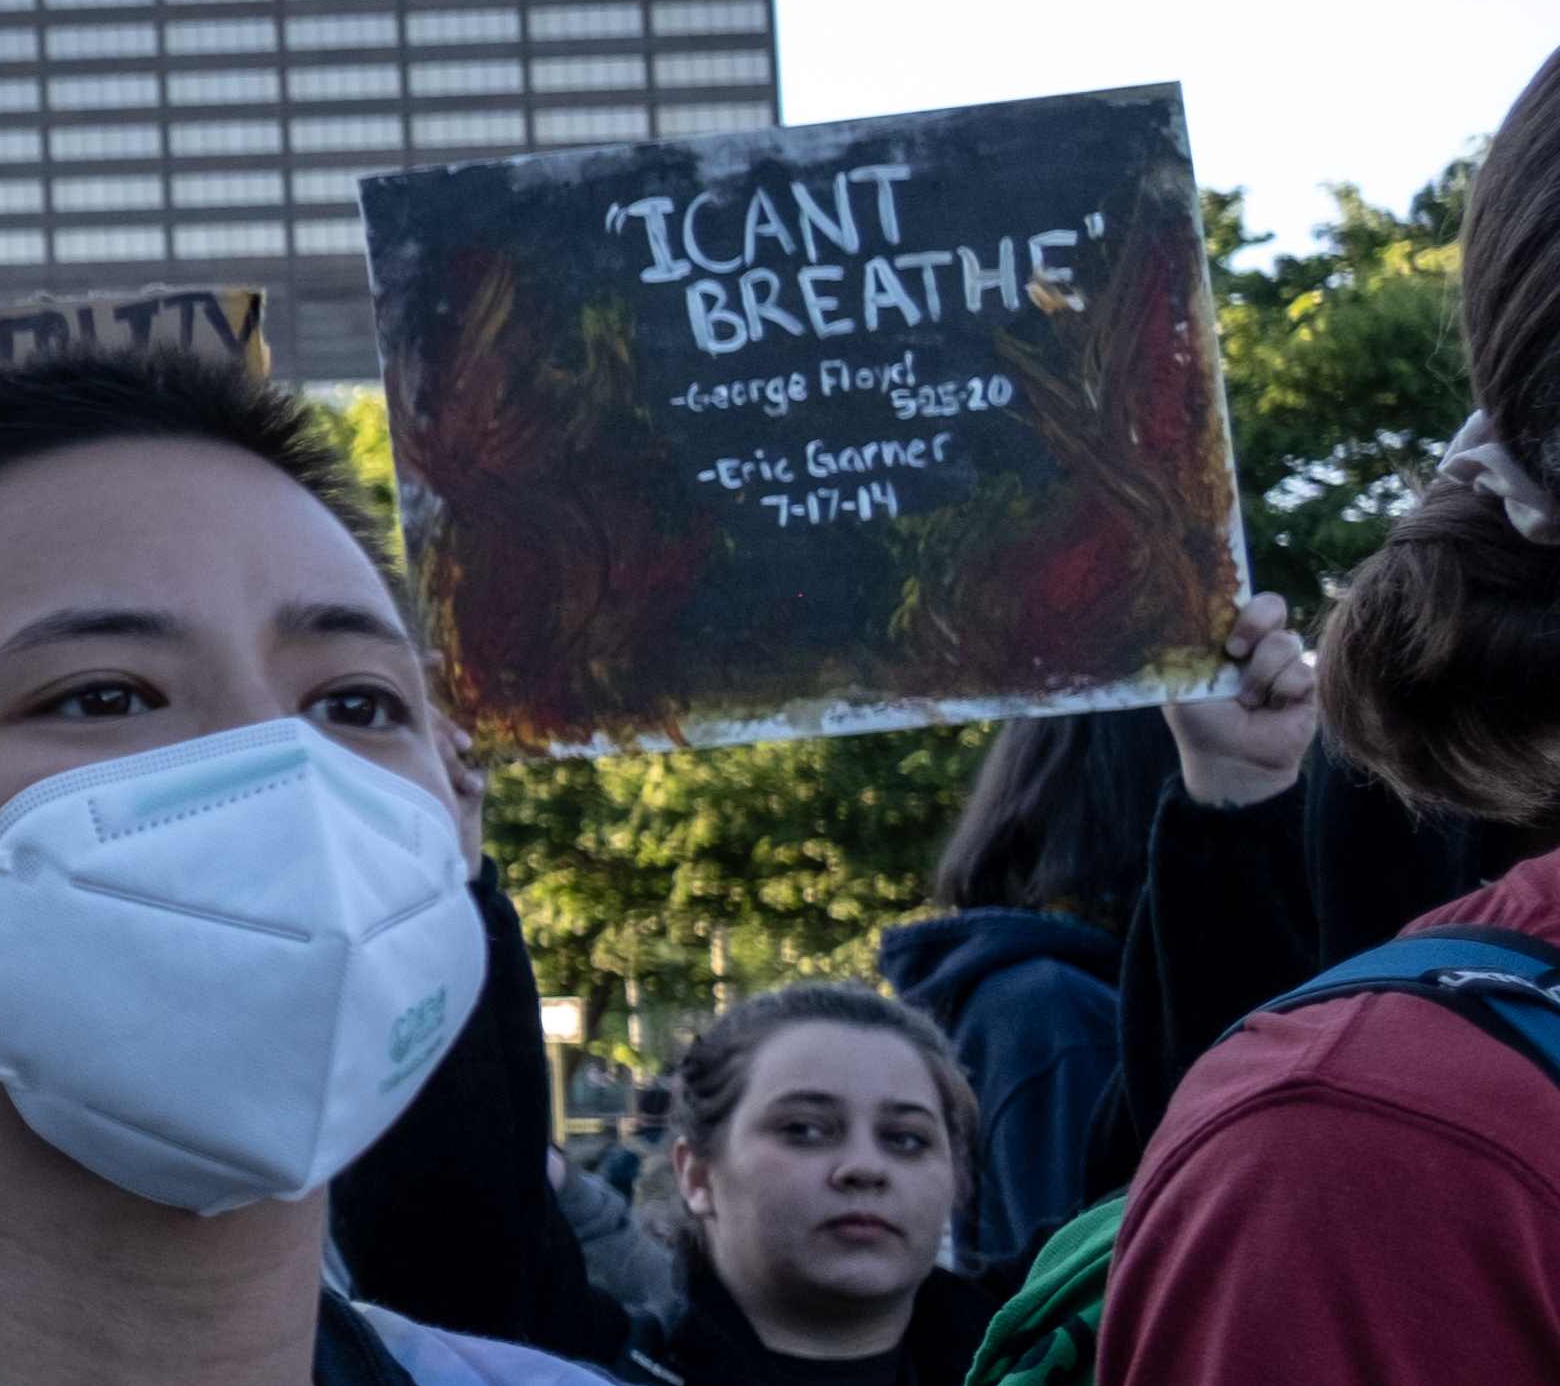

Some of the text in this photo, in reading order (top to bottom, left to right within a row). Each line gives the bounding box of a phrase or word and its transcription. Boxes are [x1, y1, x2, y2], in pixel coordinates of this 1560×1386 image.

[819, 350, 916, 397] Floyd
[806, 432, 952, 478] Garner
[760, 480, 898, 527] 7-17-14
